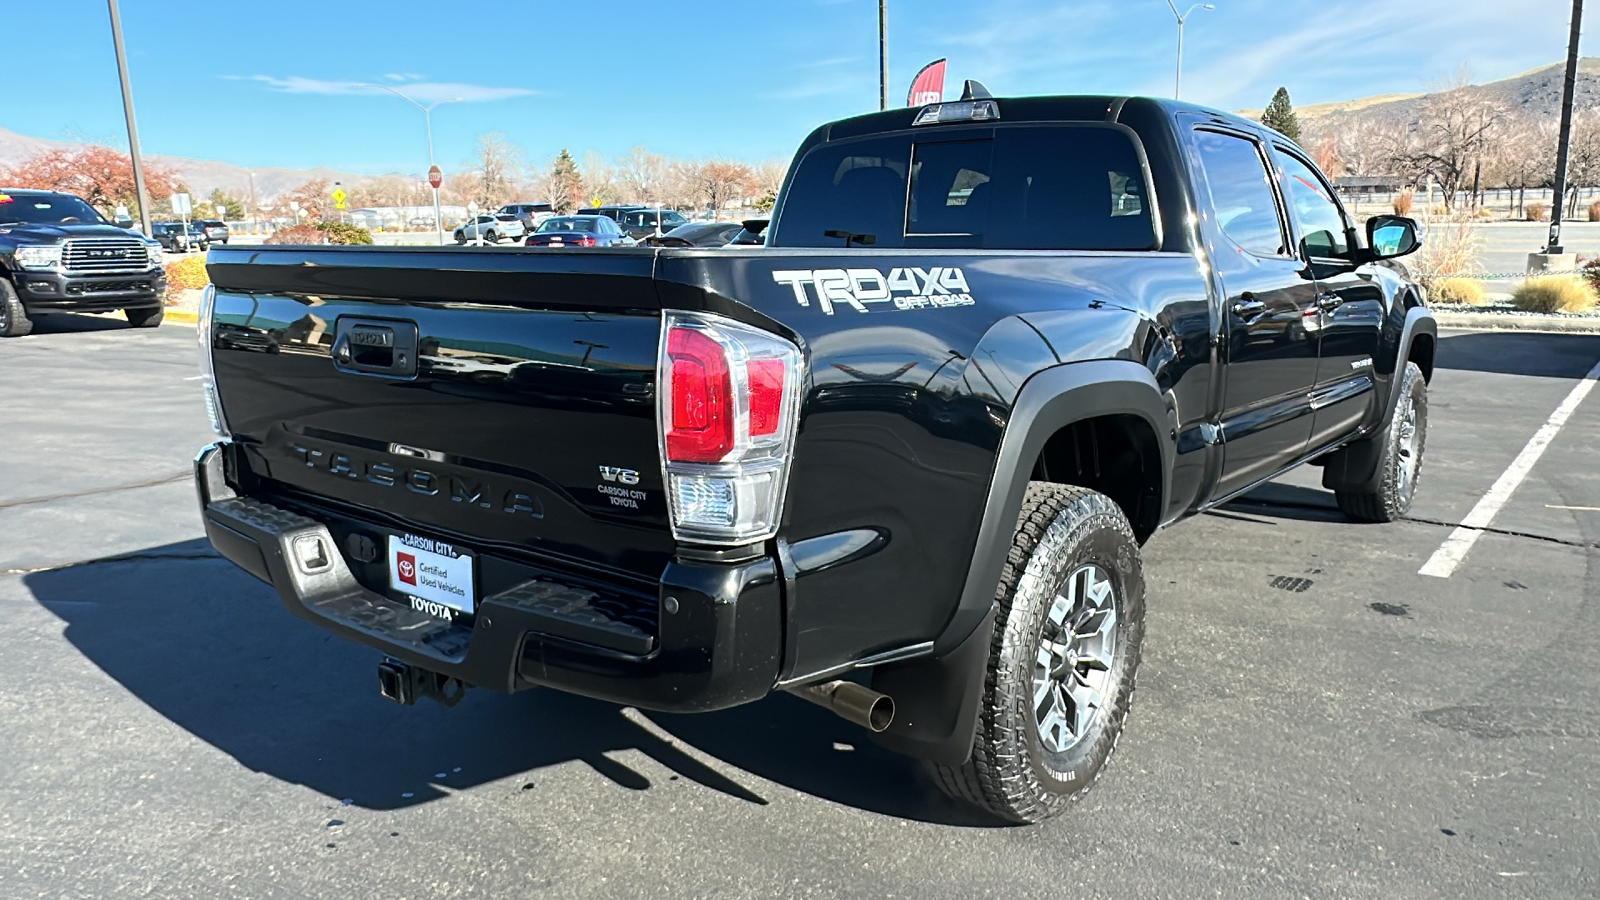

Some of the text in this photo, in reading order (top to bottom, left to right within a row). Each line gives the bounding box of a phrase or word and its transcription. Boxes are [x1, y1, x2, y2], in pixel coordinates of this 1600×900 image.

[914, 91, 940, 107] USED
[429, 172, 442, 182] STOP
[772, 267, 970, 315] TRD 4X4
[893, 293, 976, 310] OFF ROAD
[287, 443, 544, 519] TACOMA
[599, 465, 640, 485] V6
[597, 484, 647, 500] CARSON CITY
[609, 496, 639, 509] TOYOTA
[404, 533, 453, 557] CARSON CITY
[419, 562, 447, 578] Certified
[420, 575, 465, 596] Used Vehicles
[409, 595, 453, 621] TOYOTA
